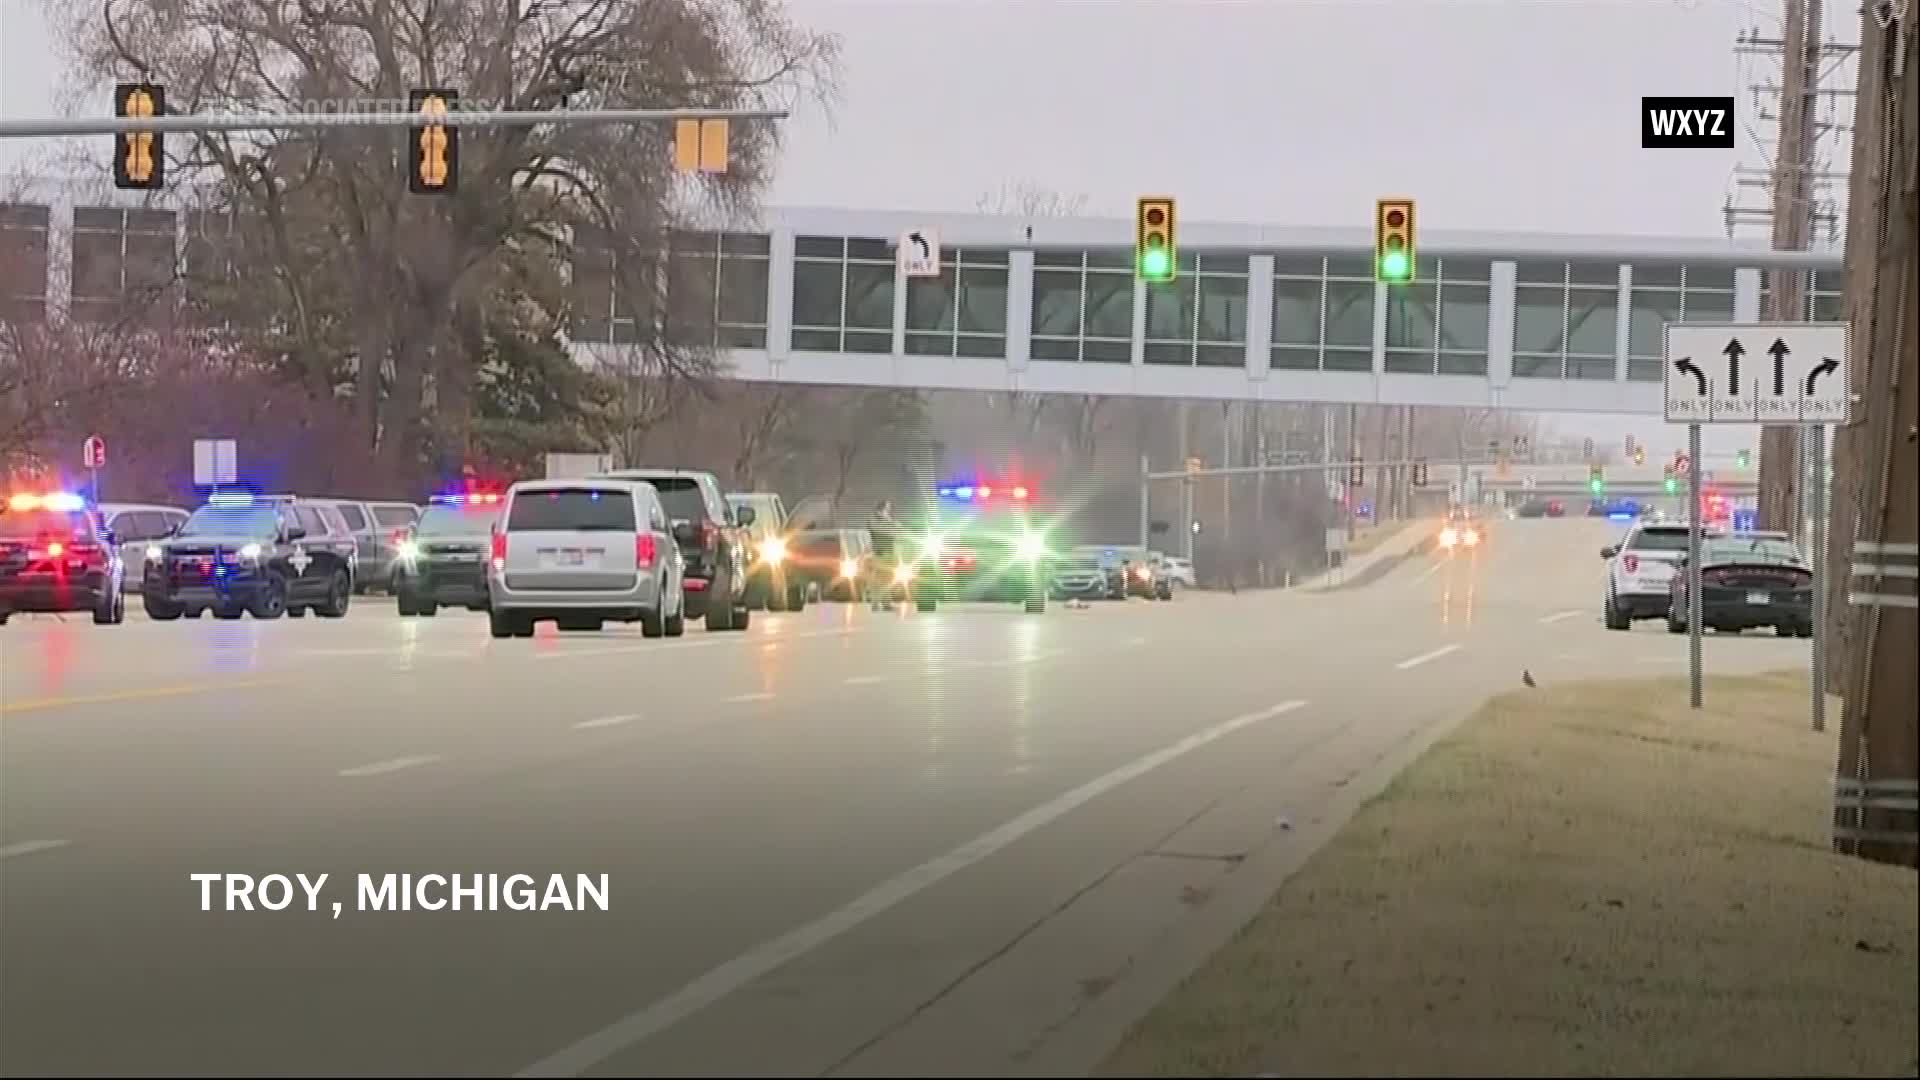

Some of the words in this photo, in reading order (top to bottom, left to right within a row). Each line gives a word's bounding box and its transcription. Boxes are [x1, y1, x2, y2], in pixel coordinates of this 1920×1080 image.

[1669, 399, 1707, 413] ONLY
[1714, 399, 1752, 413] ONLY
[1759, 399, 1797, 413] ONLY
[1804, 399, 1843, 413] ONLY
